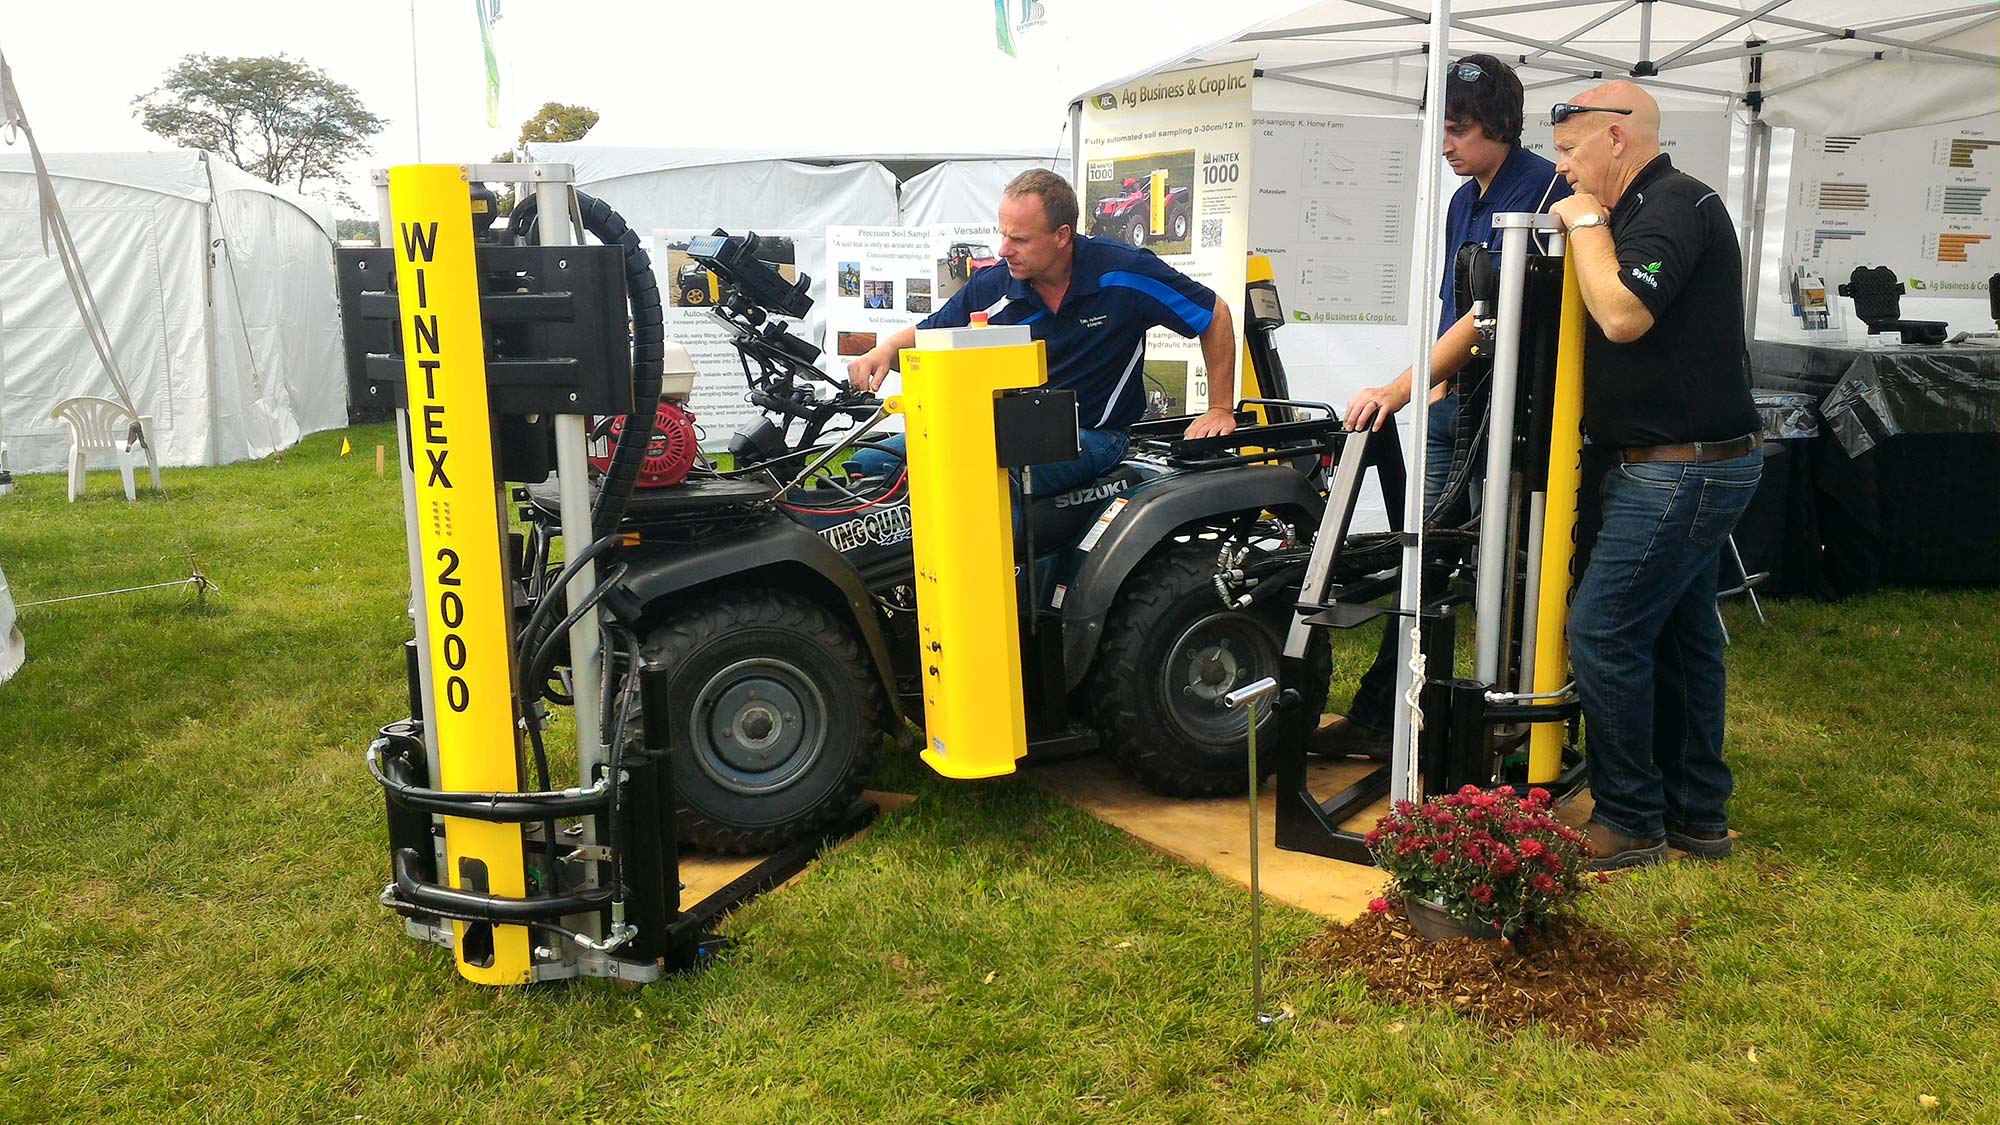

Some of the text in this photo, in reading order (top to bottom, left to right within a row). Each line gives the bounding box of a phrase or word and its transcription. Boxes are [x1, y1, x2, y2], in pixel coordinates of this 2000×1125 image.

[1121, 88, 1136, 109] Ag
[1140, 83, 1184, 103] Business
[1187, 79, 1196, 96] &
[1199, 76, 1225, 97] Crop
[1227, 74, 1247, 91] Inc.
[1327, 120, 1344, 129] Farm
[1085, 135, 1105, 147] Fully
[1106, 132, 1143, 145] automated
[1144, 130, 1157, 140] soil
[1158, 127, 1193, 140] sampling
[1090, 169, 1113, 180] 1000
[1203, 163, 1239, 185] 1000
[858, 229, 890, 238] Precision
[891, 229, 906, 238] Soil
[954, 226, 991, 235] Versatile
[1929, 280, 1990, 291] Ag Business & Cro
[1313, 312, 1324, 323] Ag
[1325, 312, 1358, 322] Business
[1359, 313, 1365, 321] &
[1365, 313, 1384, 324] Crop
[1147, 341, 1182, 349] hydraulic
[401, 222, 453, 488] WINTEX
[1055, 479, 1129, 509] SUZUKI
[436, 548, 470, 713] 2000
